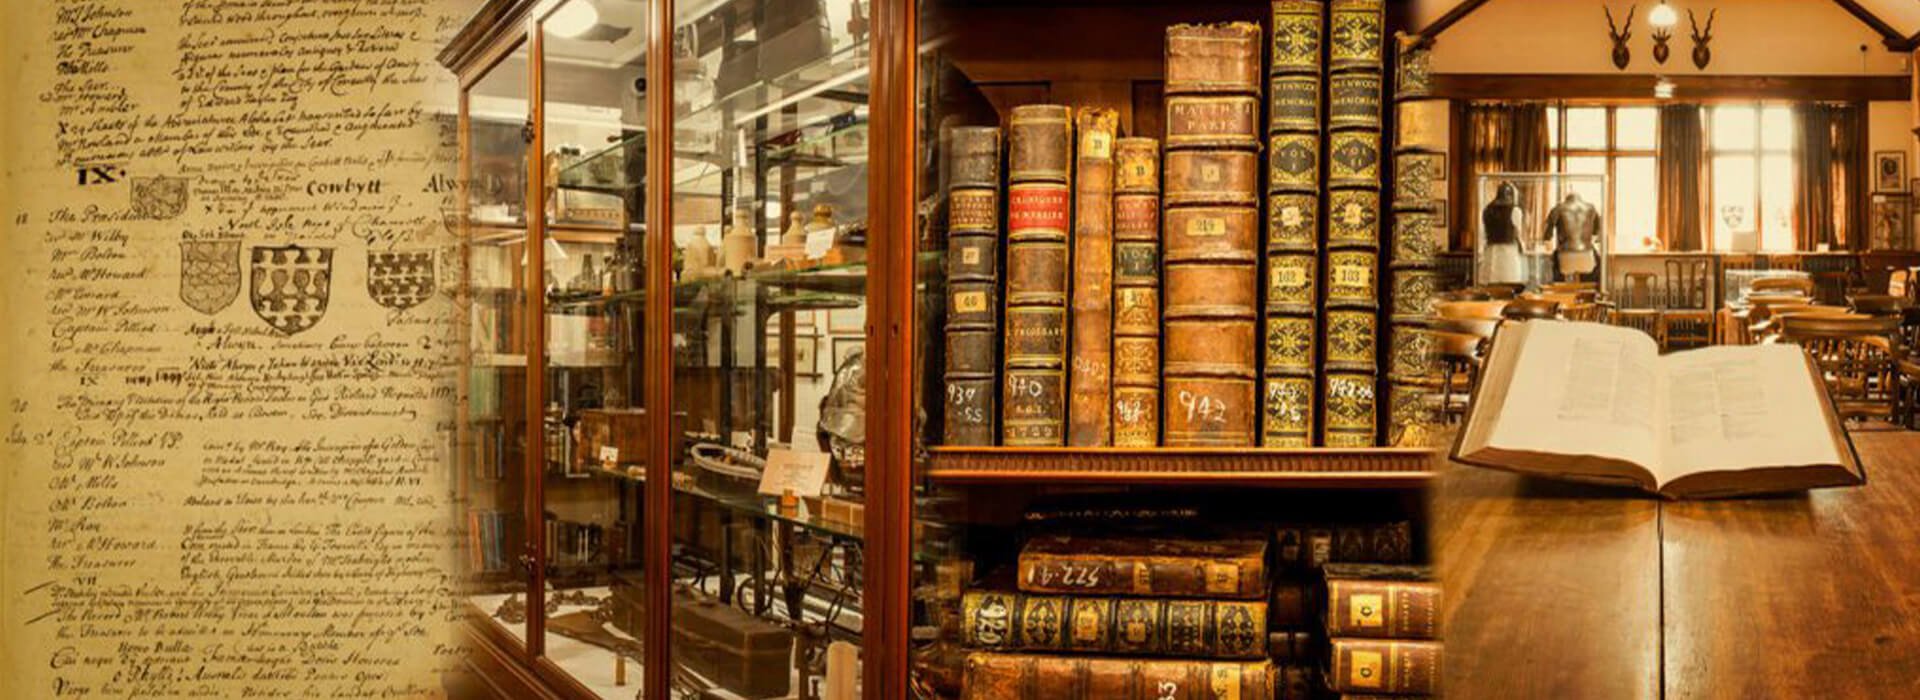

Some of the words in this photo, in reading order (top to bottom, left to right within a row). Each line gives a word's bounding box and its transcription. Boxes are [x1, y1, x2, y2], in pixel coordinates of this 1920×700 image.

[1341, 270, 1360, 283] 103
[1008, 373, 1043, 398] 940
[1178, 391, 1227, 423] 942
